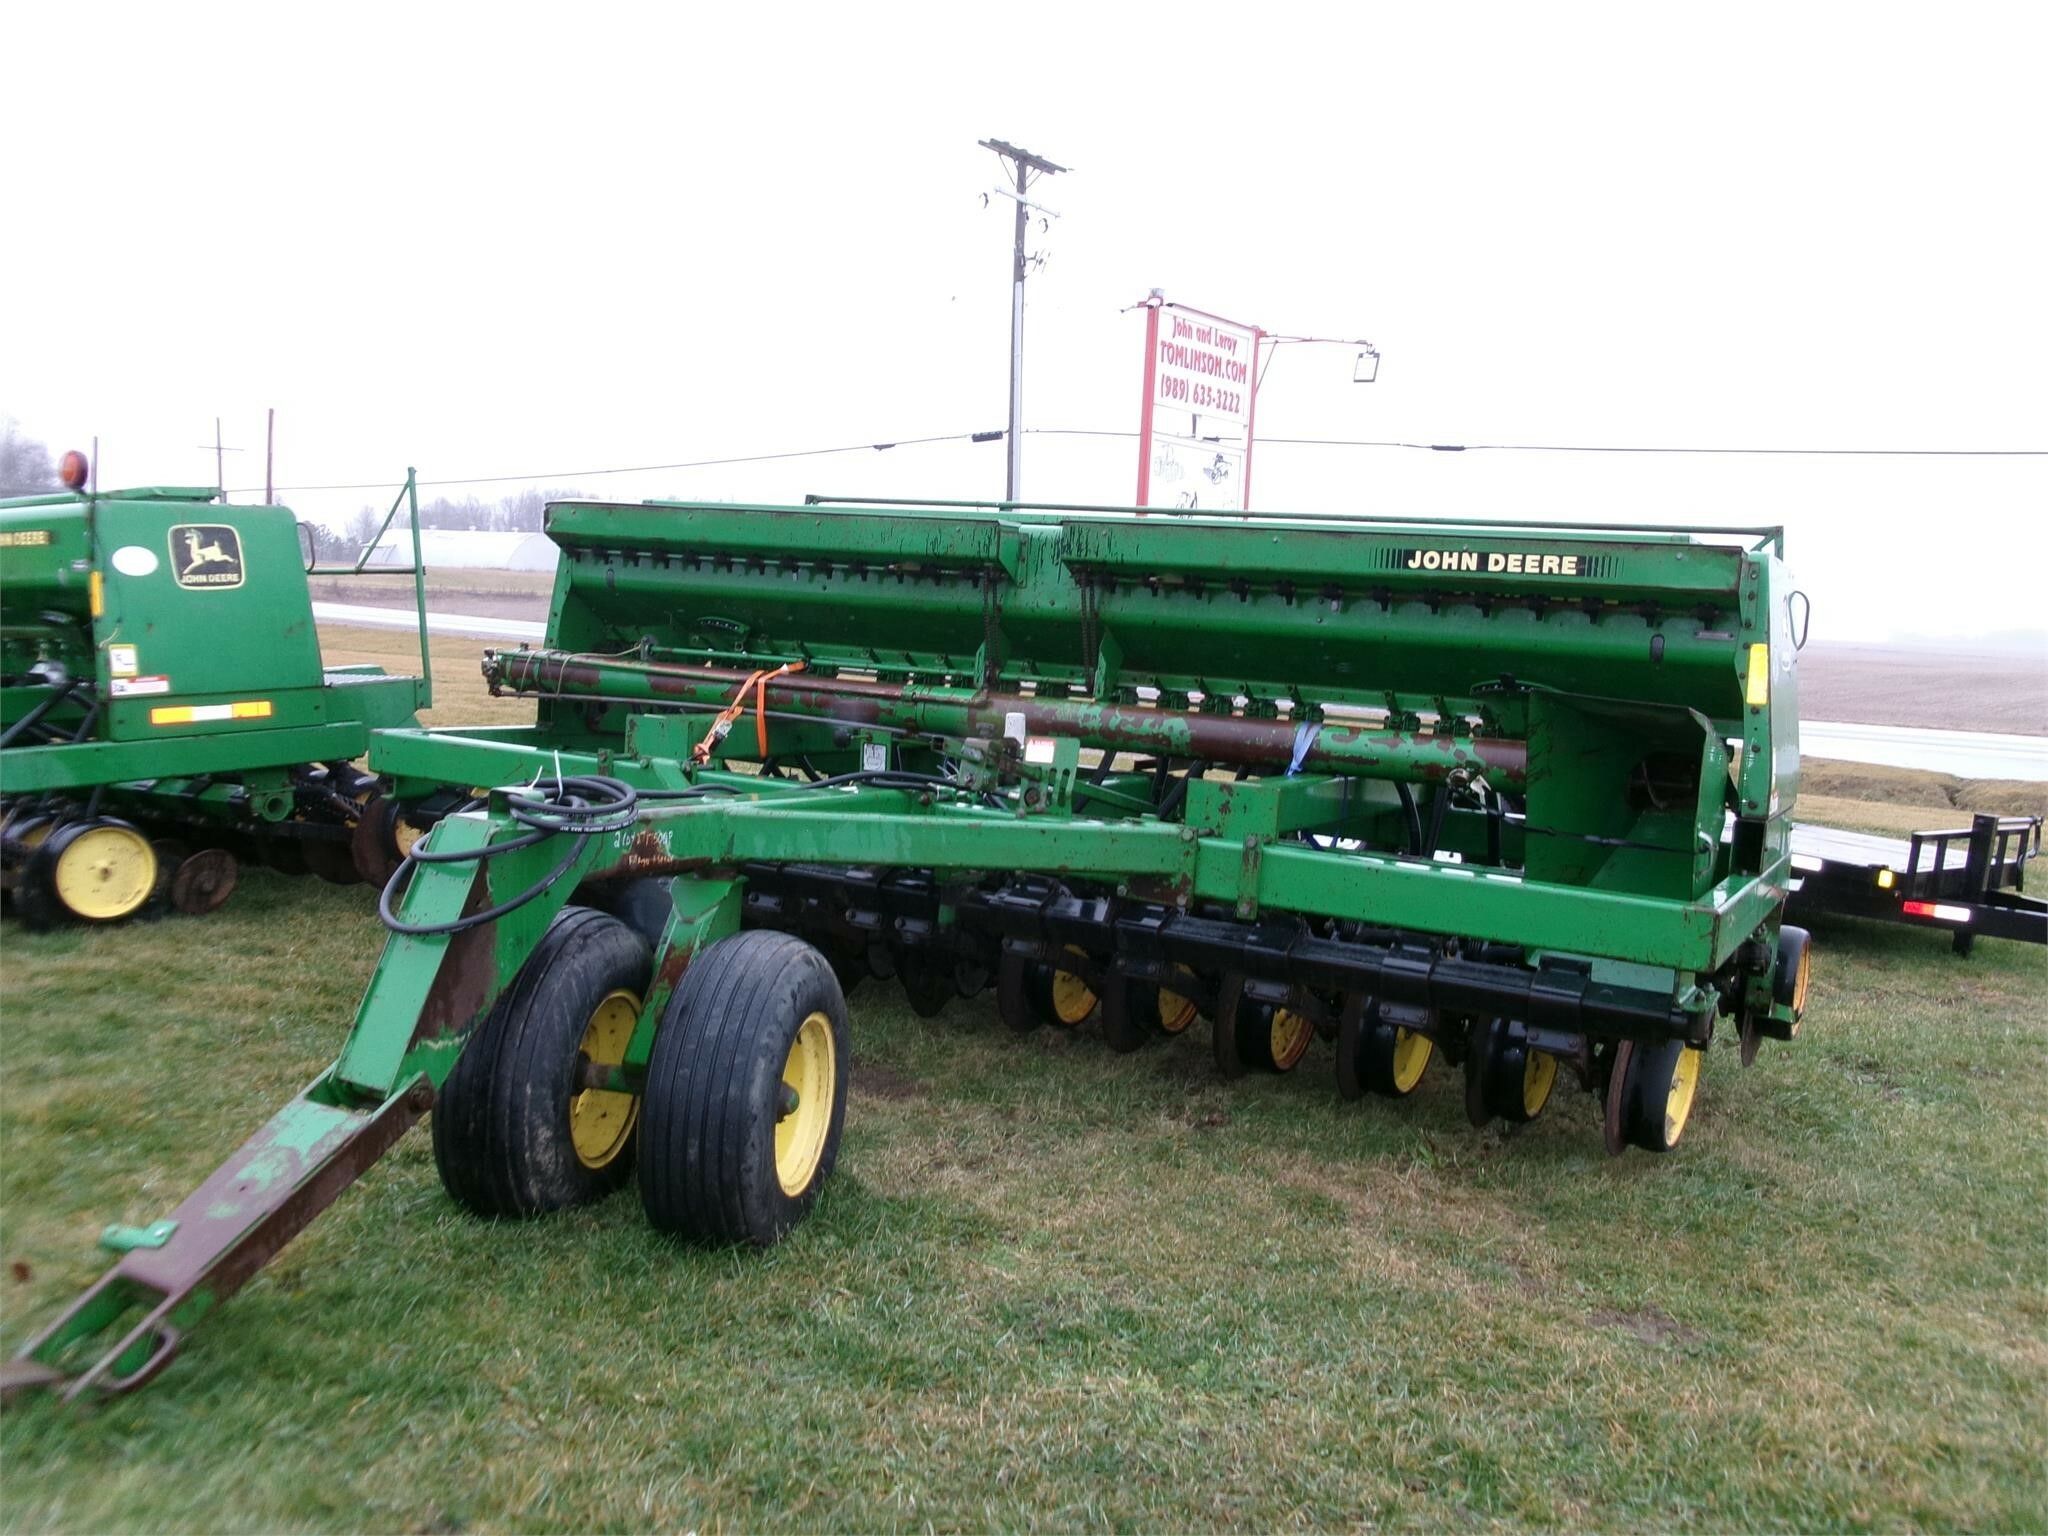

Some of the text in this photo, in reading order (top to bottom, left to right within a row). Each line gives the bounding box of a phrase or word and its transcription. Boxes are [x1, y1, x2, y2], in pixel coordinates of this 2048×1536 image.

[1173, 315, 1237, 356] John and Leroy
[1161, 340, 1246, 384] TOMLINSON.COM
[1161, 373, 1240, 413] (989) 635-3222
[181, 573, 240, 583] JOHN DEERE
[1408, 550, 1578, 575] JOHN DEERE
